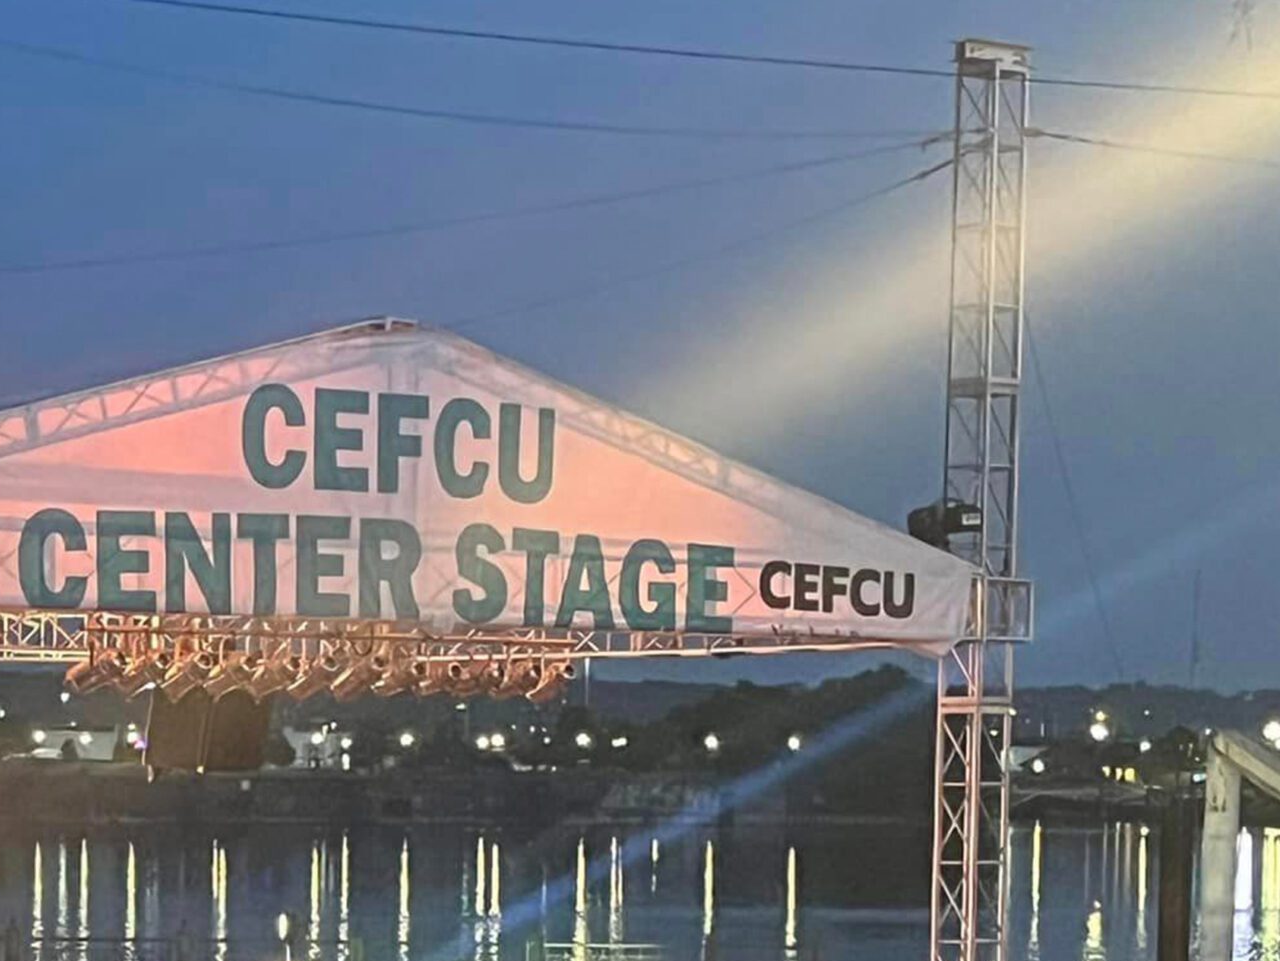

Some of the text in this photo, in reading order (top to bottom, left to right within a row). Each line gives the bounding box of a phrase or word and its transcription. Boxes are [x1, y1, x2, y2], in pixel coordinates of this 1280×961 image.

[242, 383, 556, 505] CEFCU
[18, 508, 736, 634] CENTER STAGE
[759, 560, 916, 619] CEFCU
